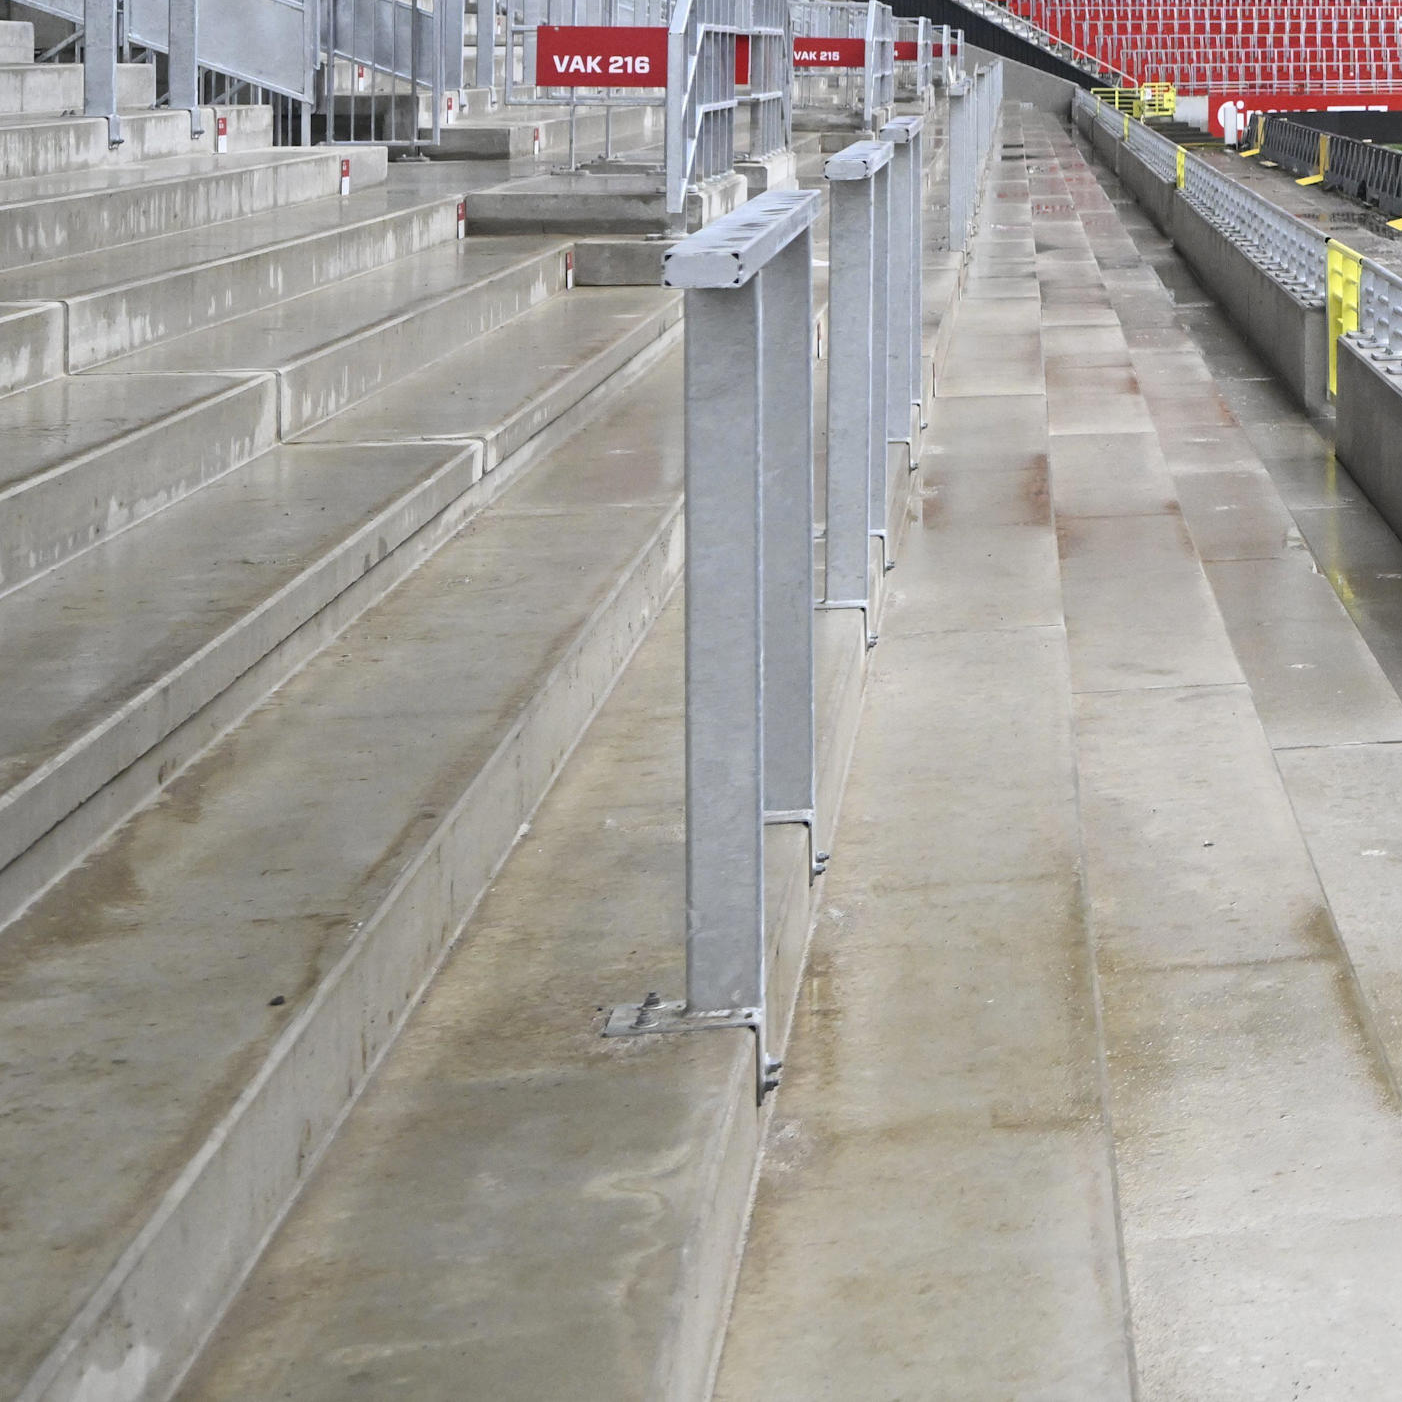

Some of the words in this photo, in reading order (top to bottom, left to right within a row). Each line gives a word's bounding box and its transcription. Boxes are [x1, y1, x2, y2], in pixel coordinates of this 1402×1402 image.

[793, 51, 817, 61] VAK
[553, 55, 602, 73] VAK
[608, 56, 650, 74] 216
